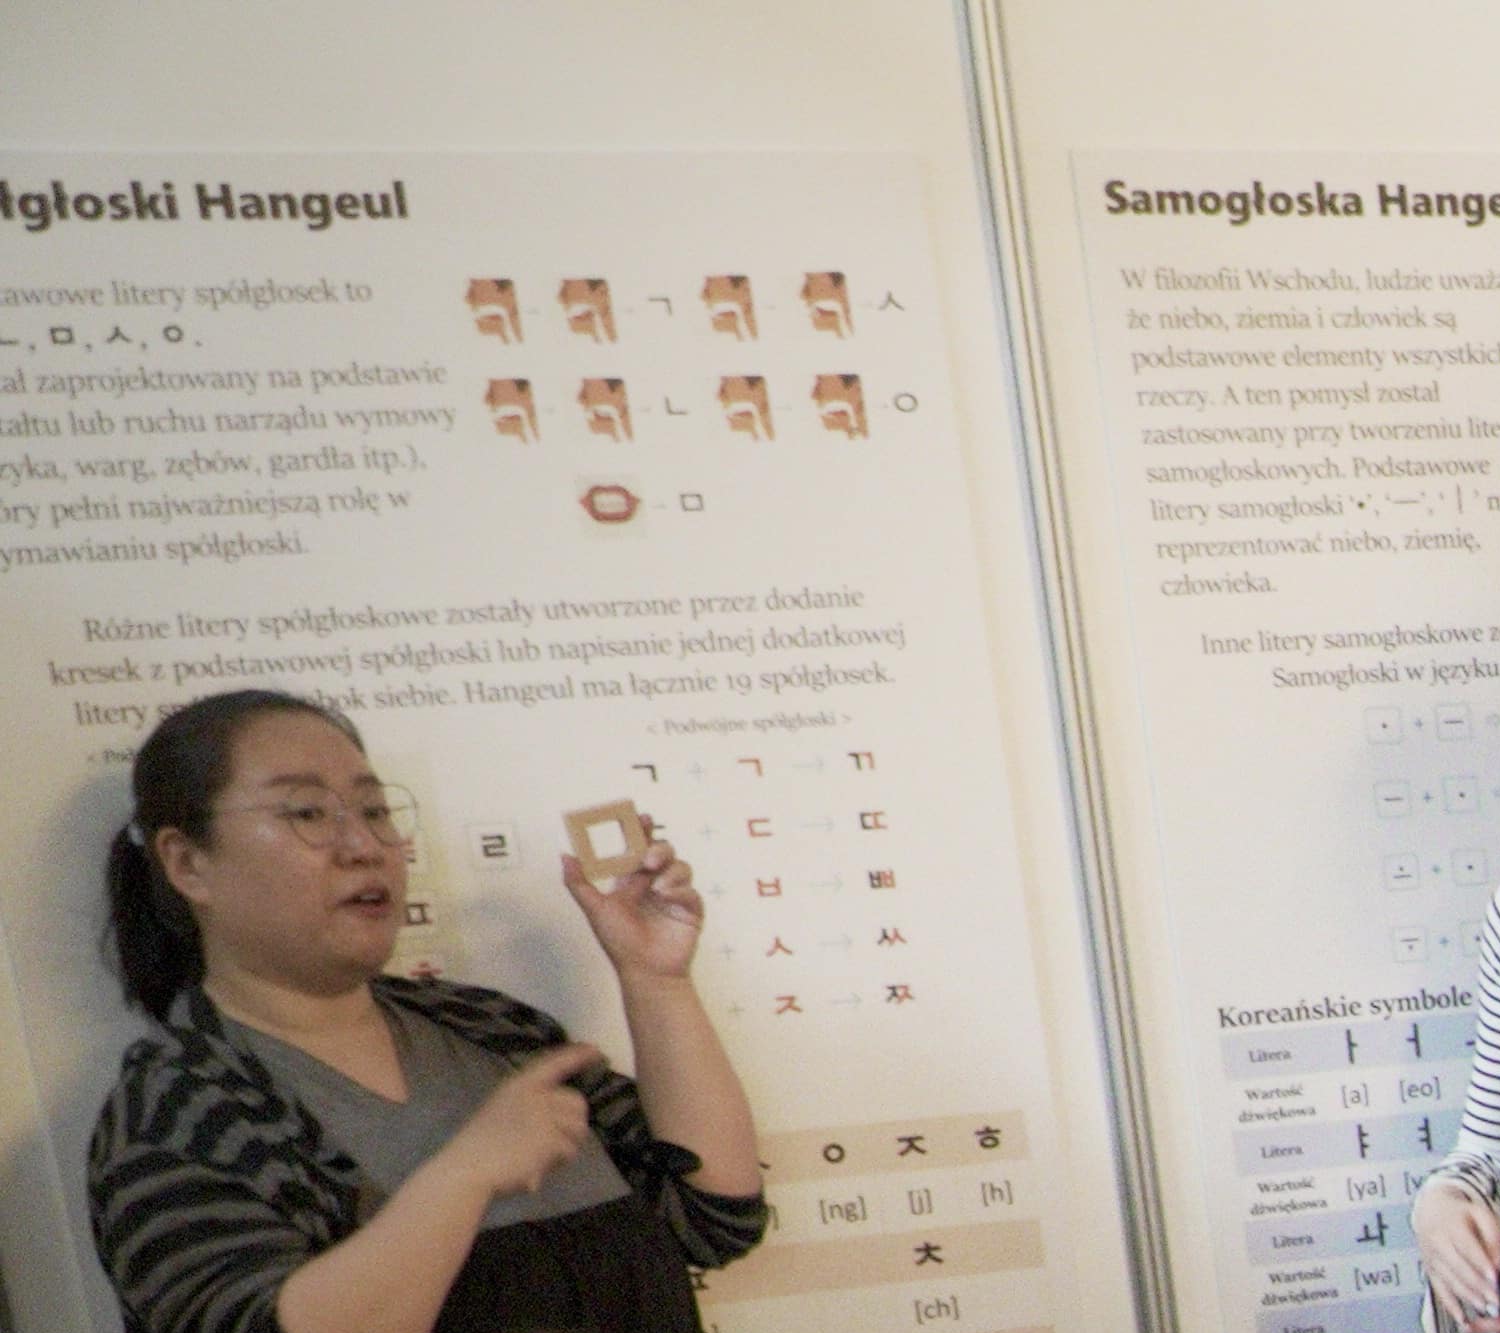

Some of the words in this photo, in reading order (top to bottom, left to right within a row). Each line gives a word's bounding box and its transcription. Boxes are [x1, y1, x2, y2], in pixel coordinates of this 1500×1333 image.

[195, 180, 409, 231] Hangeul
[1103, 180, 1364, 228] Samogłoska
[111, 280, 185, 311] litery
[197, 278, 338, 313] spółgłosek
[345, 281, 373, 303] to
[1119, 267, 1147, 291] W
[1153, 266, 1241, 293] filozofii
[1245, 268, 1361, 294] Wschodu,
[1366, 268, 1433, 292] ludzie
[1127, 308, 1152, 331] że
[1159, 307, 1231, 334] niebo,
[1236, 309, 1311, 330] ziemia
[1316, 307, 1325, 329] i
[1330, 306, 1427, 330] człowiek
[1433, 312, 1458, 334] są
[1130, 345, 1276, 376] podstawowe
[1282, 345, 1385, 373] elementy
[36, 366, 259, 399] zaprojektowany
[268, 372, 302, 389] na
[312, 362, 448, 394] podstawie
[1136, 386, 1216, 412] rzeczy.
[1222, 383, 1241, 406] A
[1245, 384, 1283, 406] ten
[1288, 382, 1371, 411] pomysł
[1376, 380, 1441, 404] został
[70, 408, 115, 436] lub
[125, 408, 207, 435] ruchu
[216, 404, 328, 436] narządu
[335, 405, 457, 433] wymowy
[1142, 423, 1287, 449] zastosowany
[1293, 425, 1342, 448] przy
[1349, 420, 1463, 442] tworzeniu
[76, 459, 156, 485] warg,
[164, 450, 262, 483] zębów,
[268, 446, 355, 480] gardła
[1145, 458, 1348, 489] samogłoskowych.
[1352, 455, 1492, 479] Podstawowe
[51, 494, 121, 528] pełni
[129, 489, 322, 524] najważniejszą
[329, 487, 381, 516] rolę
[388, 490, 412, 508] w
[1150, 498, 1211, 525] litery
[1216, 493, 1345, 523] samogłoski
[165, 531, 310, 566] spółgłoski.
[1156, 531, 1325, 564] reprezentować
[1330, 529, 1400, 555] niebo,
[1160, 571, 1278, 598] człowieka.
[82, 615, 170, 643] Różne
[177, 611, 249, 641] litery
[257, 604, 438, 641] spółgłoskowe
[446, 599, 536, 629] zostały
[543, 598, 681, 623] utworzone
[689, 591, 758, 621] przez
[765, 586, 865, 613] dodanie
[47, 656, 143, 688] kresek
[150, 662, 166, 681] z
[172, 649, 352, 686] podstawowej
[359, 641, 492, 674] spółgłoski
[499, 638, 542, 663] lub
[548, 632, 673, 665] napisanie
[679, 628, 757, 661] jednej
[762, 621, 907, 652] dodatkowej
[1202, 632, 1253, 657] Inne
[1258, 627, 1318, 655] litery
[1323, 622, 1484, 652] samogłoskowe
[1271, 660, 1402, 691] Samogłoski
[1406, 664, 1425, 682] w
[73, 699, 148, 731] litery
[373, 682, 458, 710] siebie.
[463, 674, 574, 707] Hangeul
[582, 680, 623, 699] ma
[630, 671, 717, 700] łącznie
[724, 673, 753, 696] 19
[759, 661, 896, 694] spółgłosek.
[1217, 996, 1365, 1029] Koreańskie
[1369, 985, 1474, 1021] symbole
[1248, 1048, 1292, 1064] Litera
[1244, 1083, 1304, 1101] Wartość
[1341, 1083, 1371, 1109] [a]
[1399, 1076, 1442, 1104] [eo]
[1260, 1143, 1304, 1160] Litera
[818, 1195, 869, 1225] [ng]
[980, 1179, 1014, 1208] [h]
[1354, 1263, 1401, 1292] [wa]
[914, 1295, 960, 1325] [ch]
